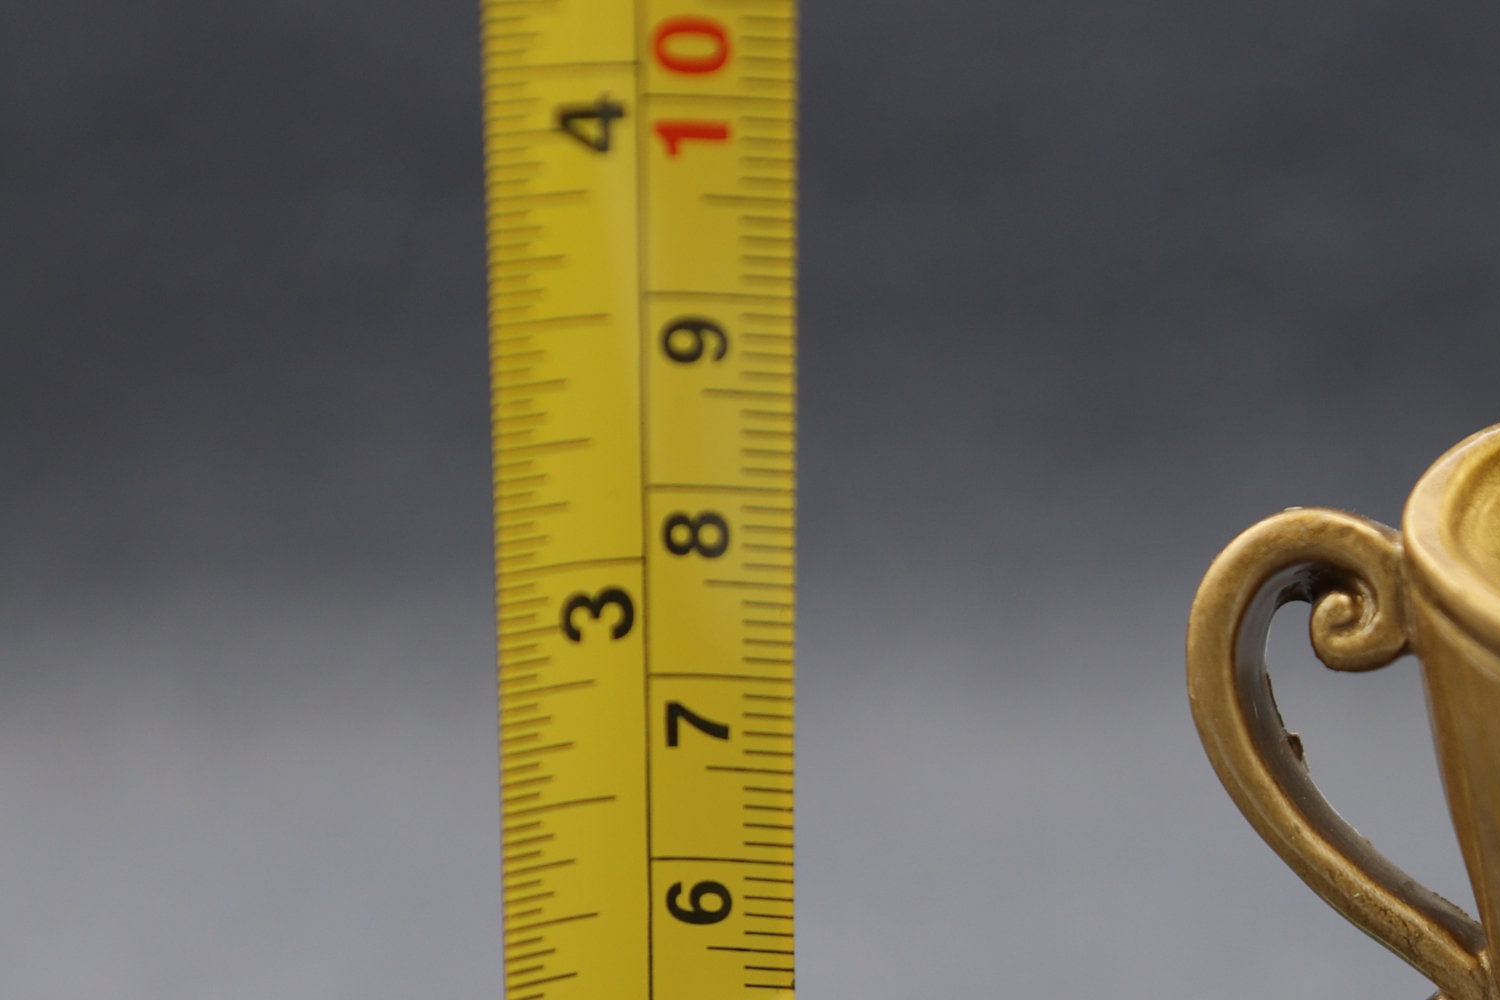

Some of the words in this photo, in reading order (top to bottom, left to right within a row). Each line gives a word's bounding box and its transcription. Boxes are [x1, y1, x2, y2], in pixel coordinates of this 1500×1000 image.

[651, 14, 733, 158] 10
[555, 93, 626, 153] 4
[660, 315, 730, 364] 9
[661, 510, 730, 559] 8
[560, 586, 635, 643] 3
[664, 701, 730, 748] 7
[665, 880, 733, 926] 6
